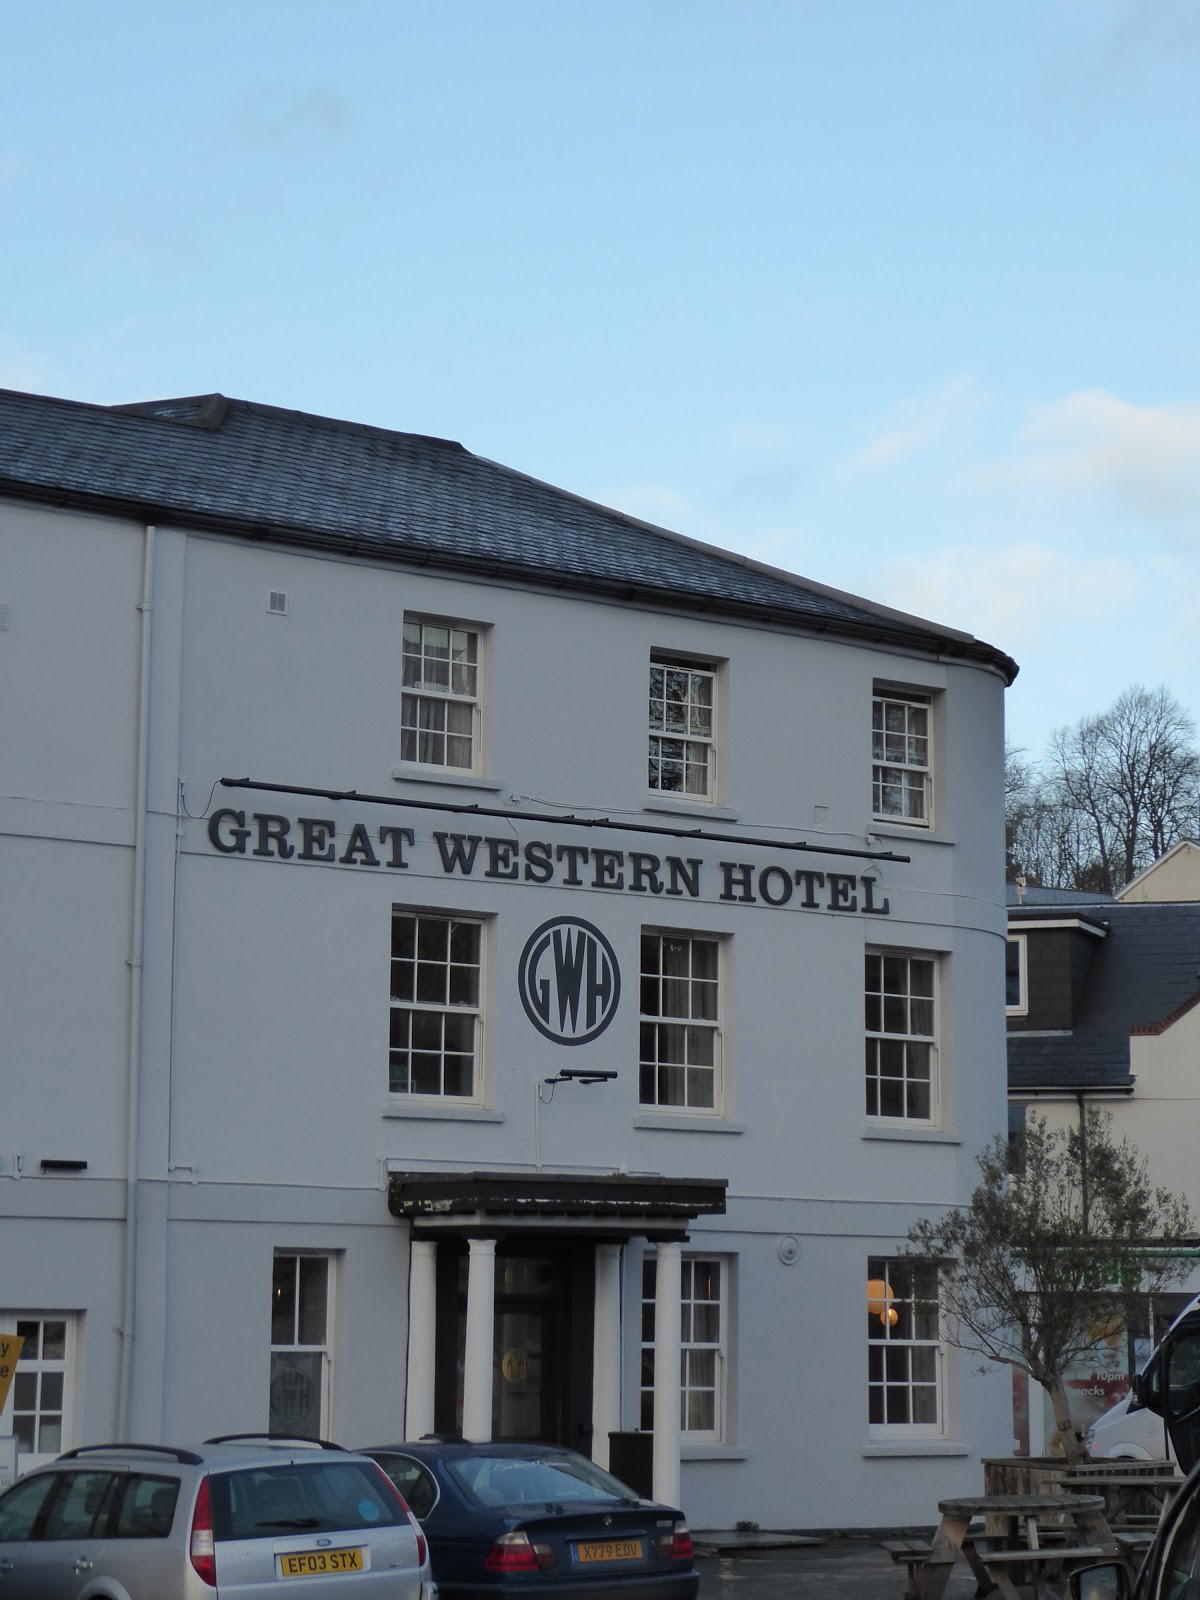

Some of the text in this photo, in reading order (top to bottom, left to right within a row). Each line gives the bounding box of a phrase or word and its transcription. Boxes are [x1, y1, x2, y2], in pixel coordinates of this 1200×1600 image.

[207, 808, 890, 915] GREAT WESTERN HOTEL
[527, 927, 612, 1034] GWH
[1097, 1370, 1125, 1383] 10pm
[583, 1542, 637, 1560] X779 EDV
[288, 1552, 358, 1573] EF03 STX
